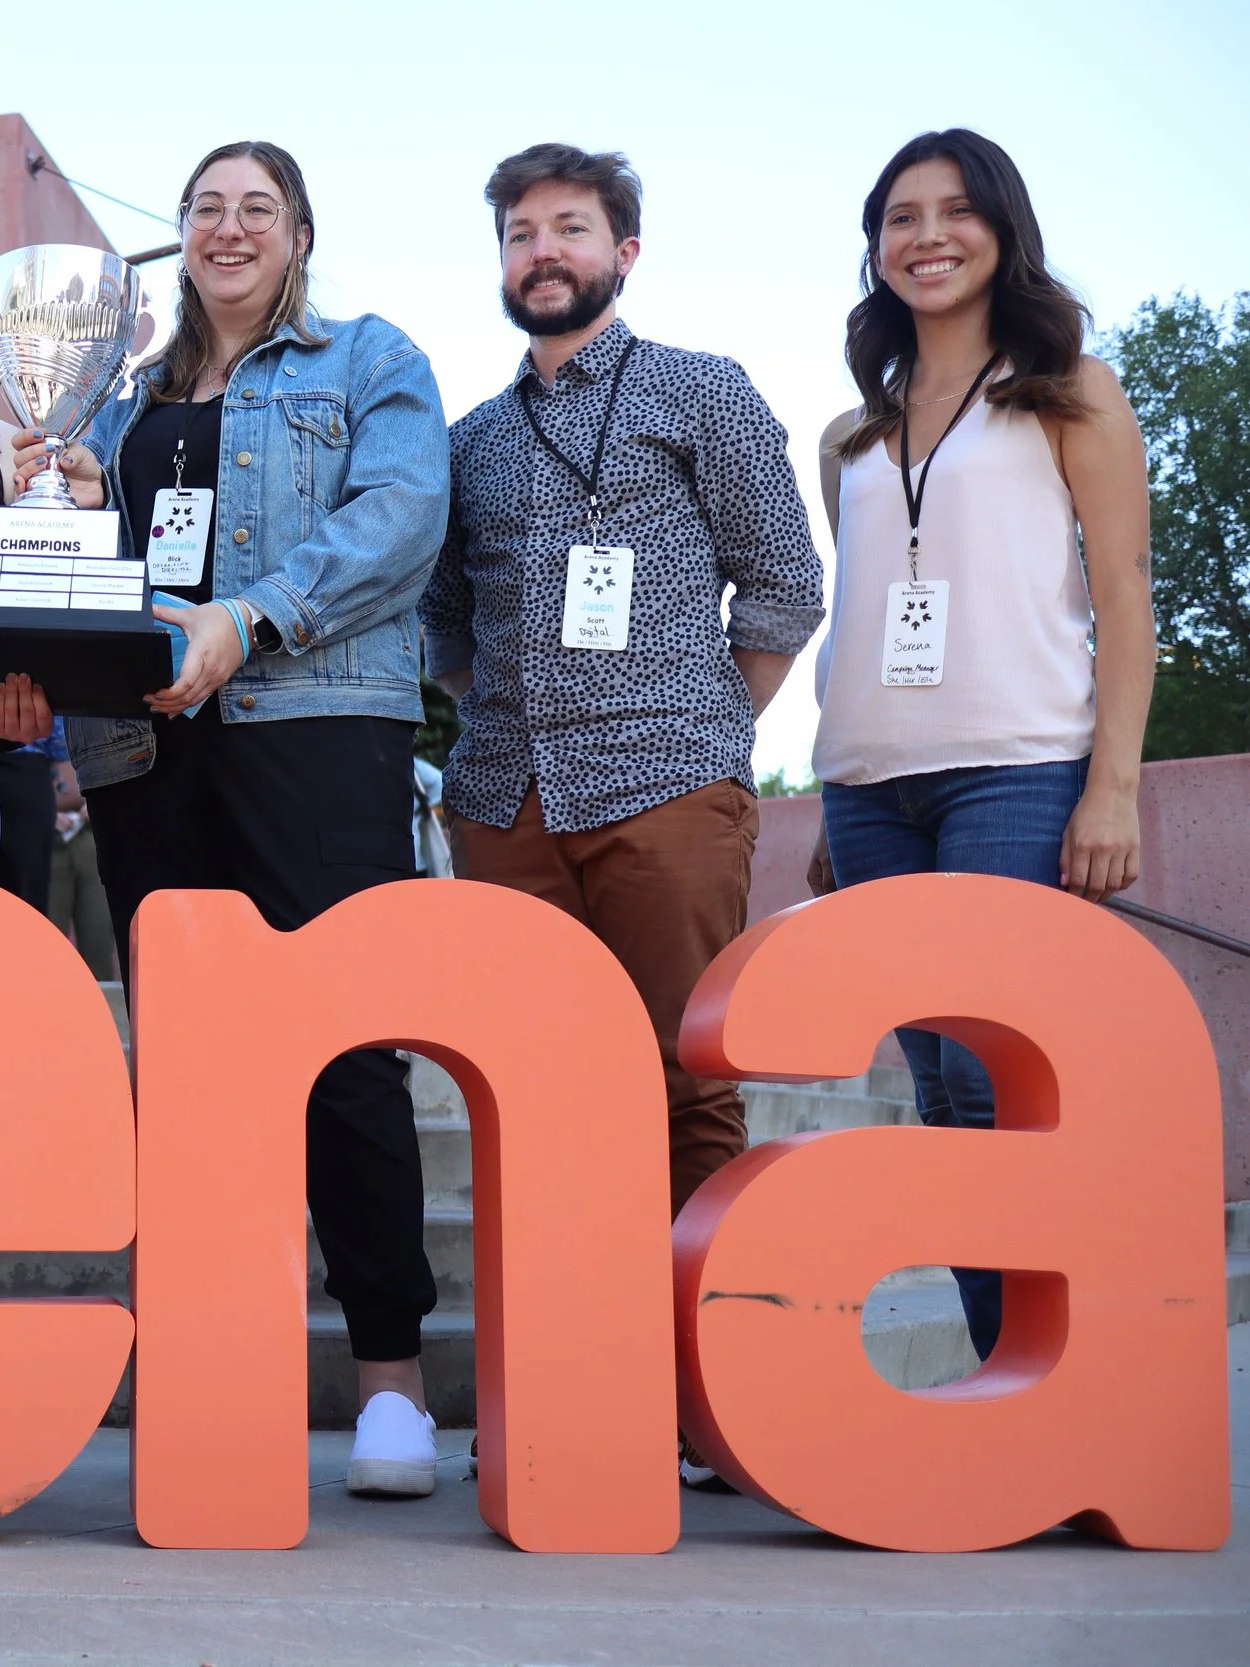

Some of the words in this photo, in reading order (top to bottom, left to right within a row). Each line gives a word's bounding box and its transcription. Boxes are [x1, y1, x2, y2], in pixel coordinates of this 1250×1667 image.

[9, 520, 36, 528] ARENA
[37, 521, 75, 529] ACADEMY
[0, 538, 81, 552] CHAMPIONS
[156, 540, 197, 551] Danielle
[579, 600, 614, 613] Jason
[587, 616, 605, 624] Scott
[579, 625, 609, 638] Digital
[894, 637, 932, 653] Serena
